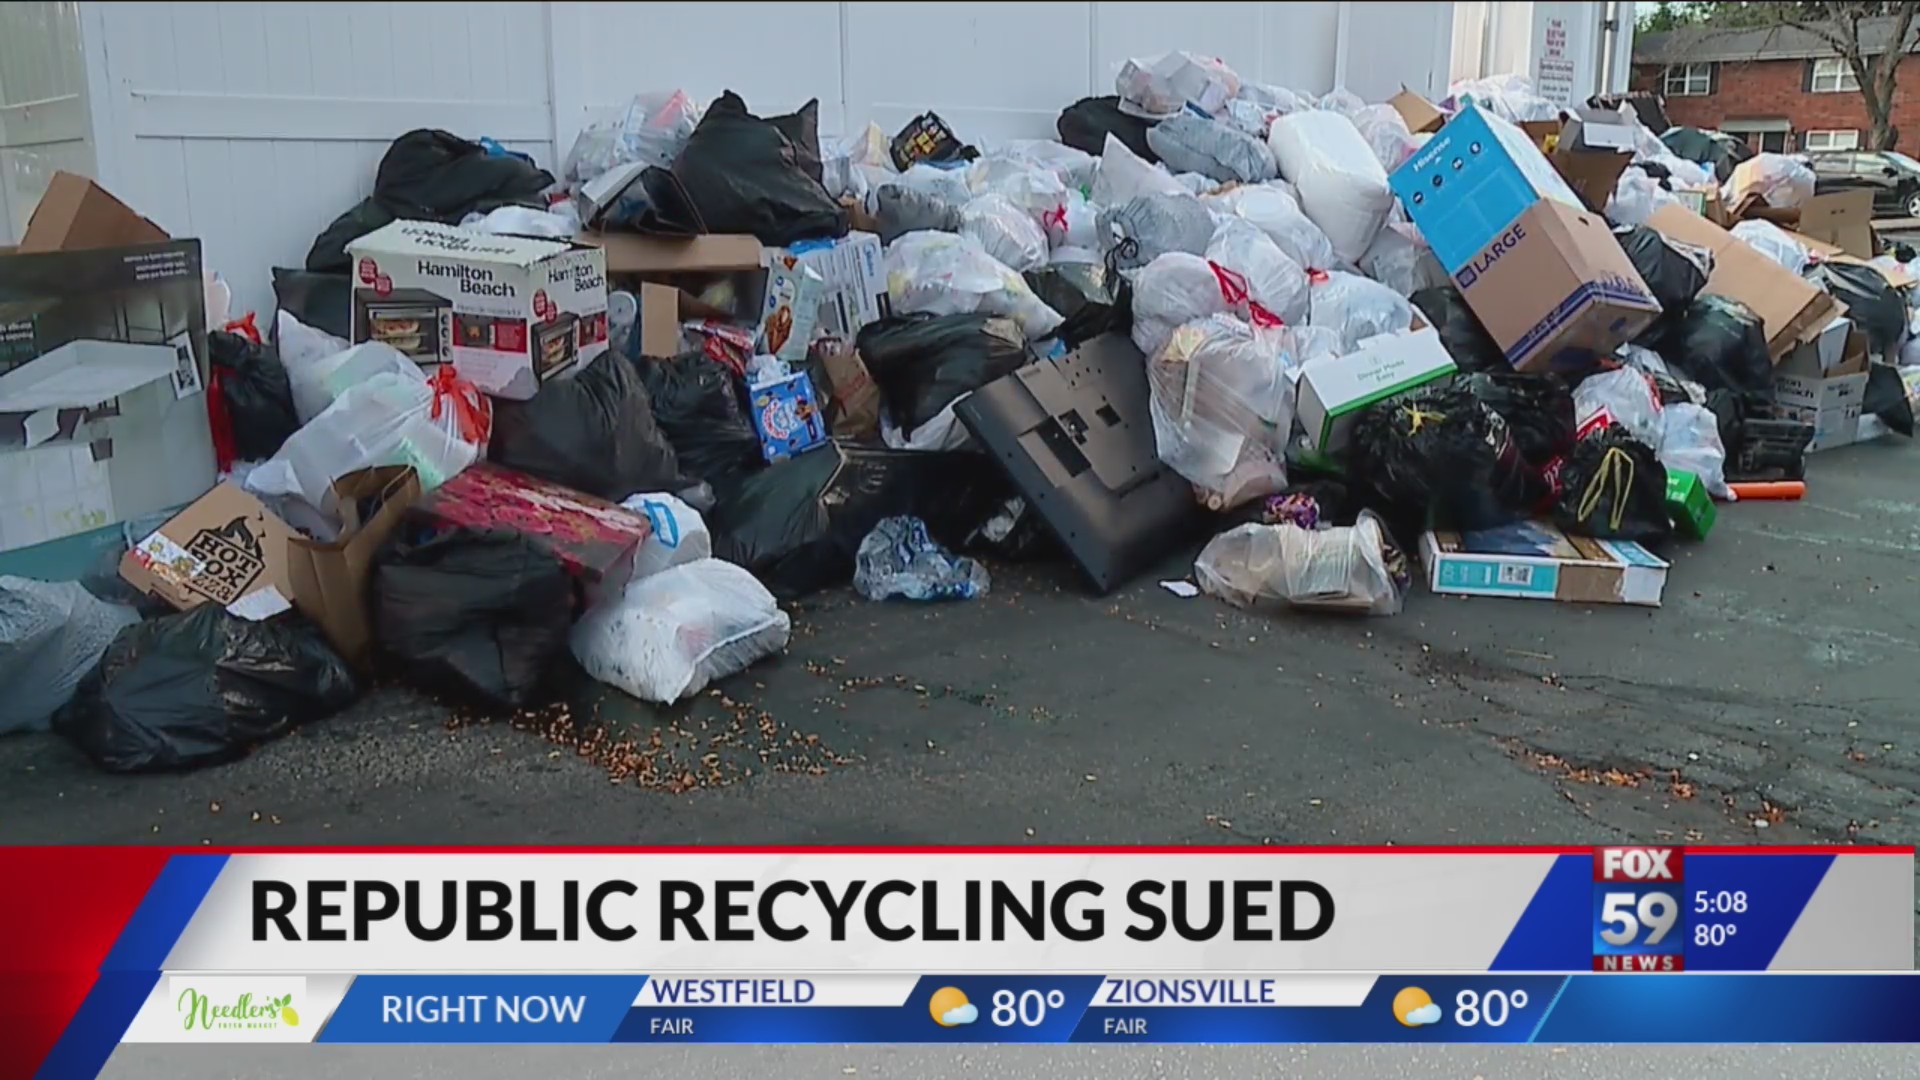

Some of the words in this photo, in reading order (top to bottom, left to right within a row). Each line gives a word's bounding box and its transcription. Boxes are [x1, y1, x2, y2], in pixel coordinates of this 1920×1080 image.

[1474, 223, 1526, 274] LARGE
[417, 260, 493, 283] Hamilton
[548, 263, 593, 285] Hamiton
[460, 280, 515, 298] Beach
[574, 273, 604, 293] Beach
[197, 534, 257, 574] HOT
